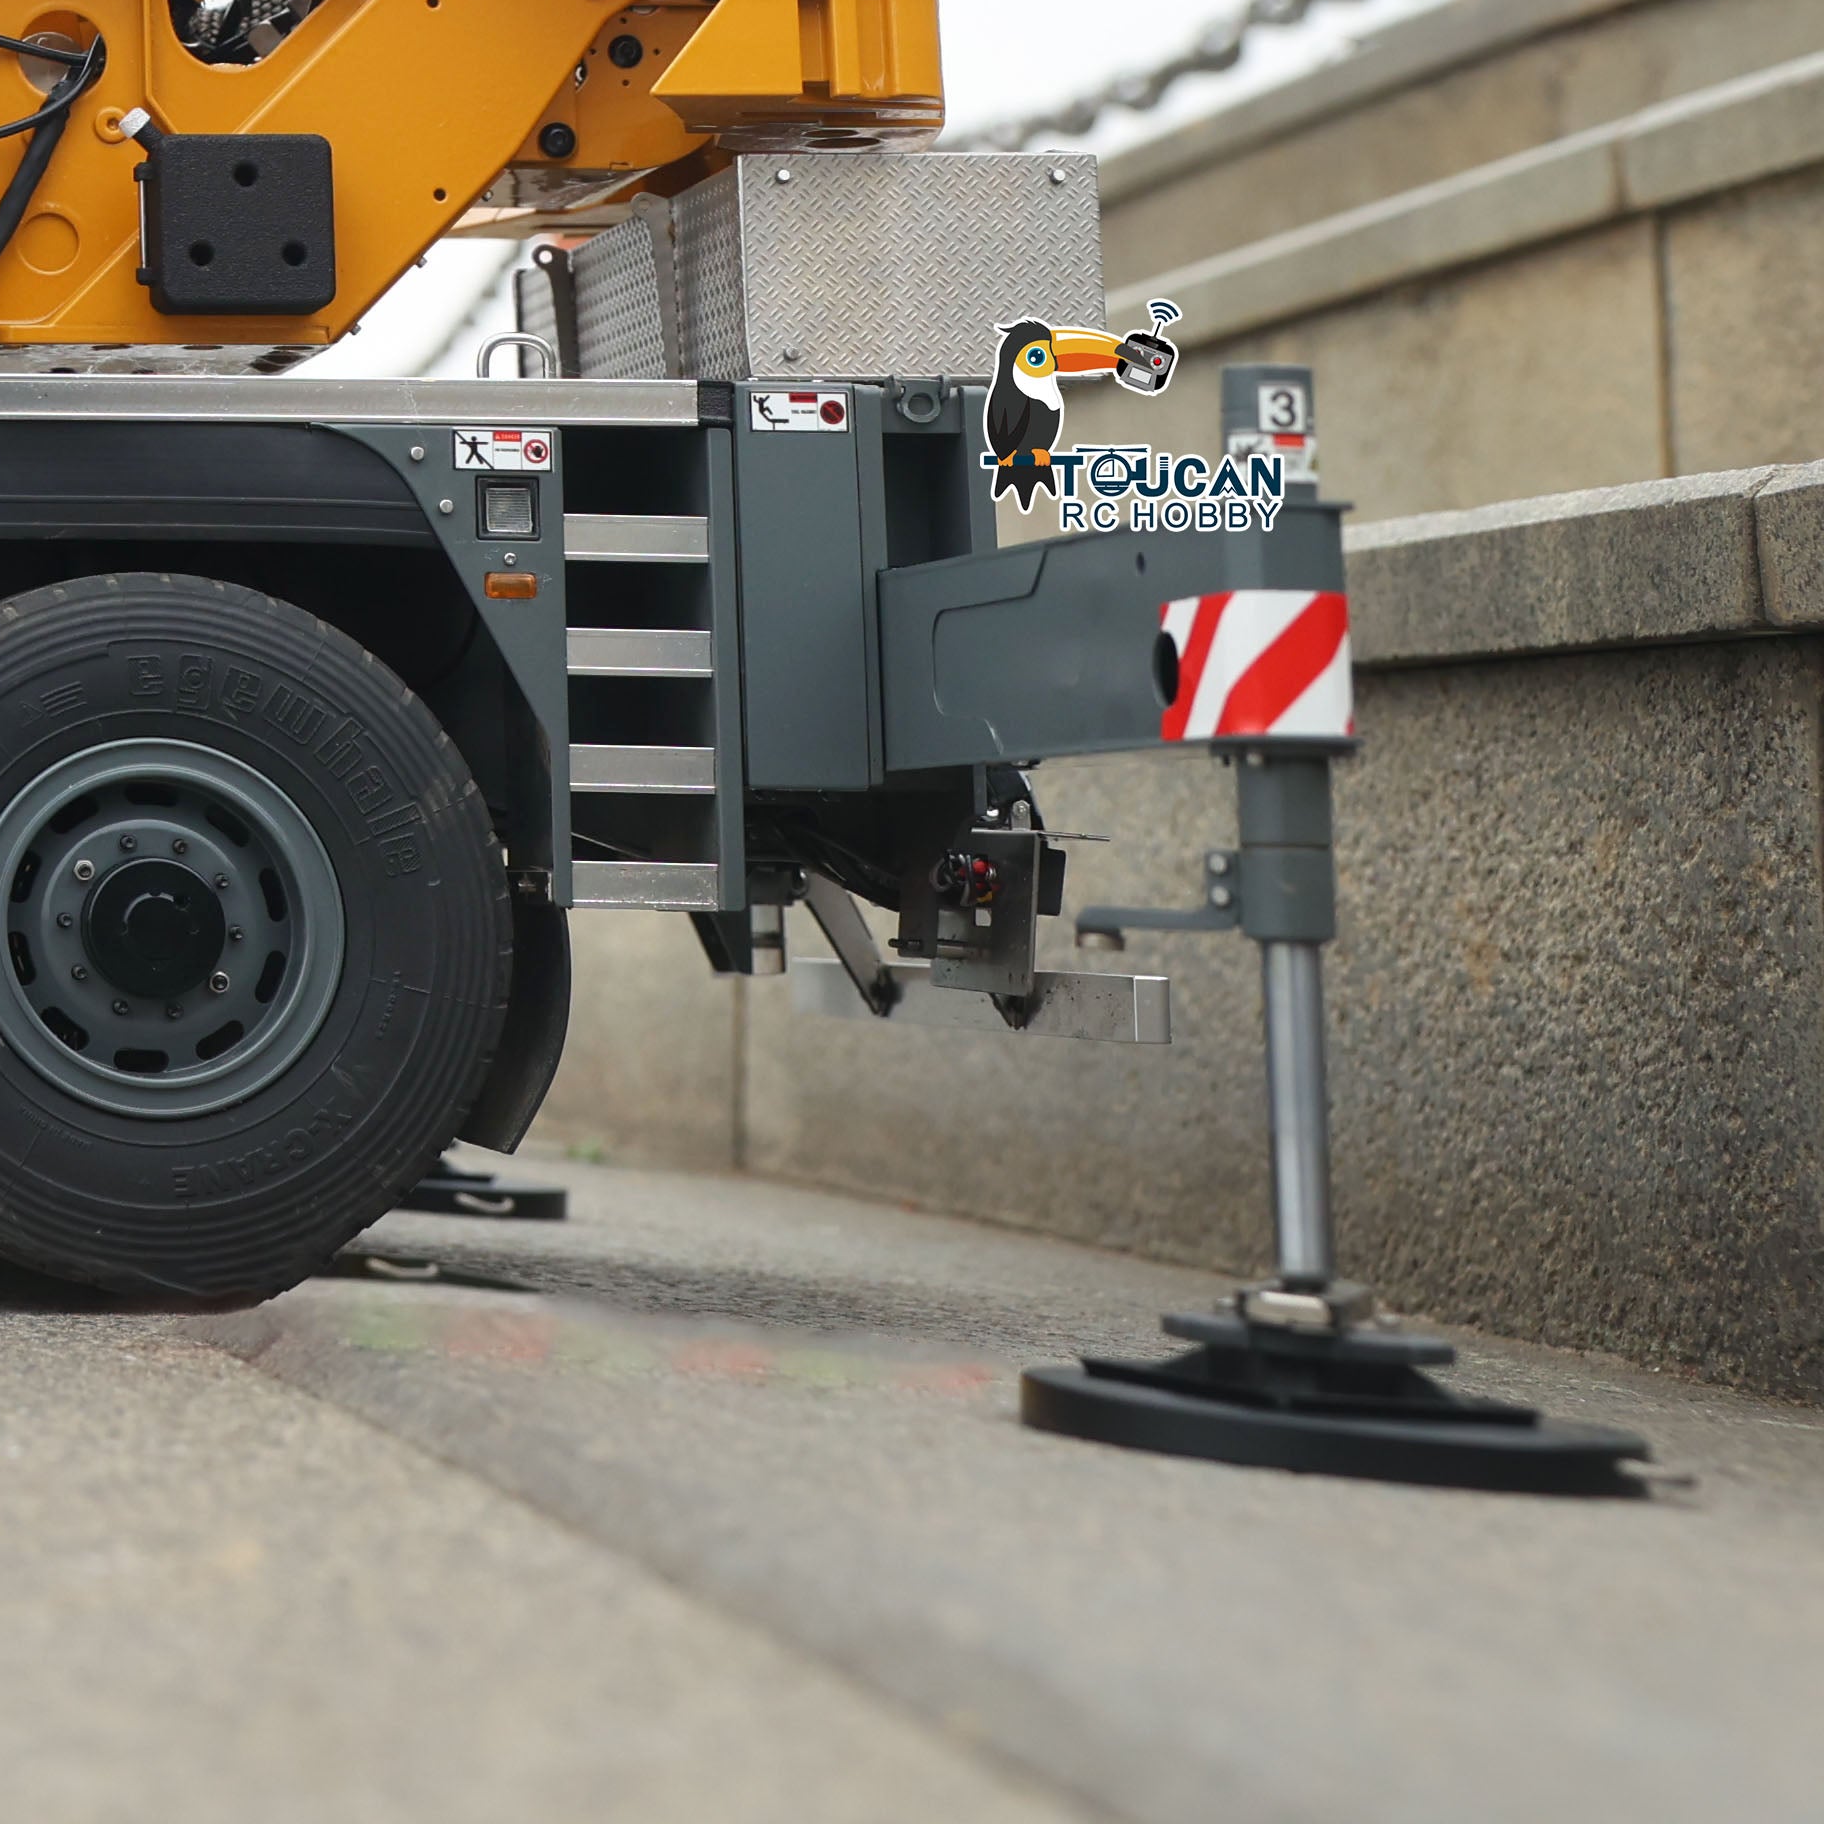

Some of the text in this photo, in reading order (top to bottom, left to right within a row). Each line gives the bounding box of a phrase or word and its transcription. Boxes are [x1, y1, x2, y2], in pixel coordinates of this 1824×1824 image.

[1269, 390, 1295, 428] 3
[127, 654, 422, 878] egewhale
[173, 1104, 356, 1197] X-CRANE
